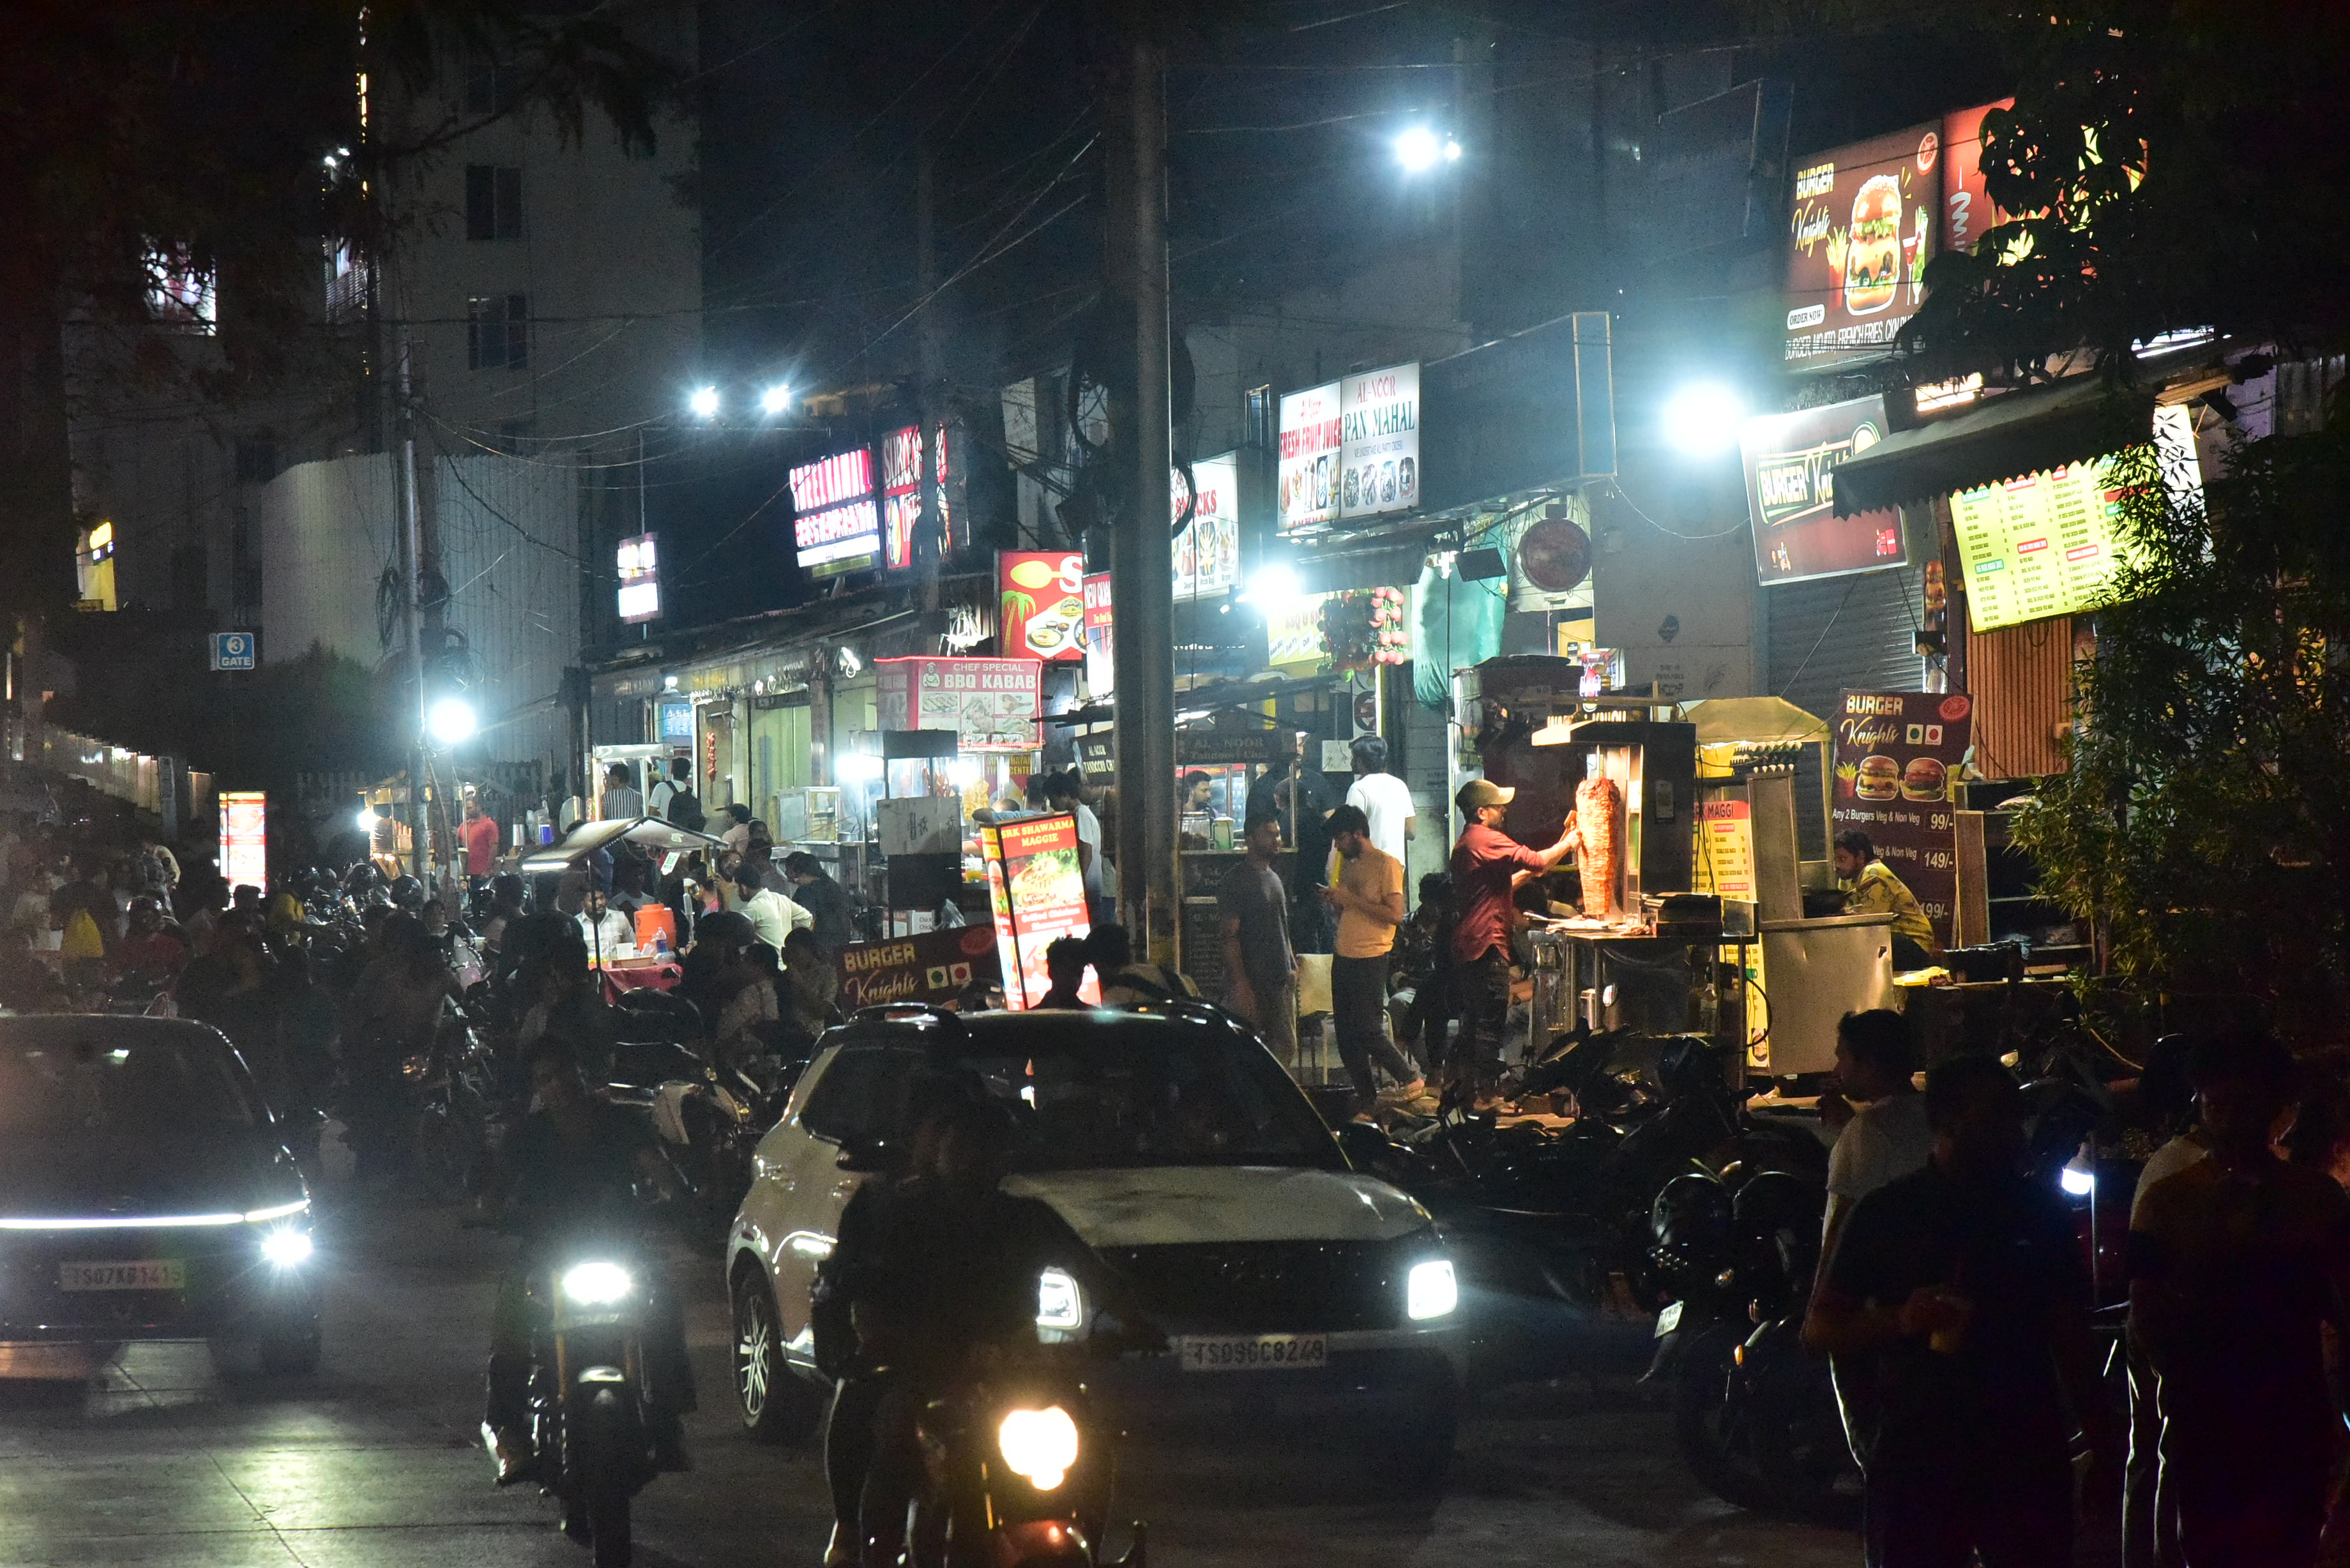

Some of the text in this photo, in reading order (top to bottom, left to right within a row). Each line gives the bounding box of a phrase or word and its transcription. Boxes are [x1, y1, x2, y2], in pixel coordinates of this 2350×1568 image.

[1796, 163, 1834, 200] BURGER
[1792, 199, 1830, 258] Knights
[1790, 313, 1808, 326] ORDER
[1838, 324, 1865, 349] FRENCH
[1344, 409, 1367, 442] PAN
[1373, 401, 1415, 437] MAHAL
[1279, 417, 1342, 461] FRESH FRUIT JUICE
[1760, 464, 1808, 506] BURGER
[1176, 490, 1217, 520] SNCKS
[1084, 583, 1096, 610] NEW
[231, 638, 241, 652] 3
[221, 656, 252, 666] GATE
[953, 663, 1025, 672] CHEF SPECIAL
[944, 674, 1036, 689] BBQ KABAB
[1846, 695, 1904, 716] BURGER
[1840, 716, 1900, 752] Knights
[1708, 803, 1734, 818] MAGGI
[1831, 808, 1953, 830] Any 2 Burgers Veg & Non Veg 99/-
[1001, 818, 1075, 839] SRK SHAWARMA
[1022, 833, 1059, 847] MAGGIE
[1872, 845, 1953, 868] Veg & Non Veg 149/-
[844, 943, 916, 972] BURGER
[844, 970, 918, 1005] Knights
